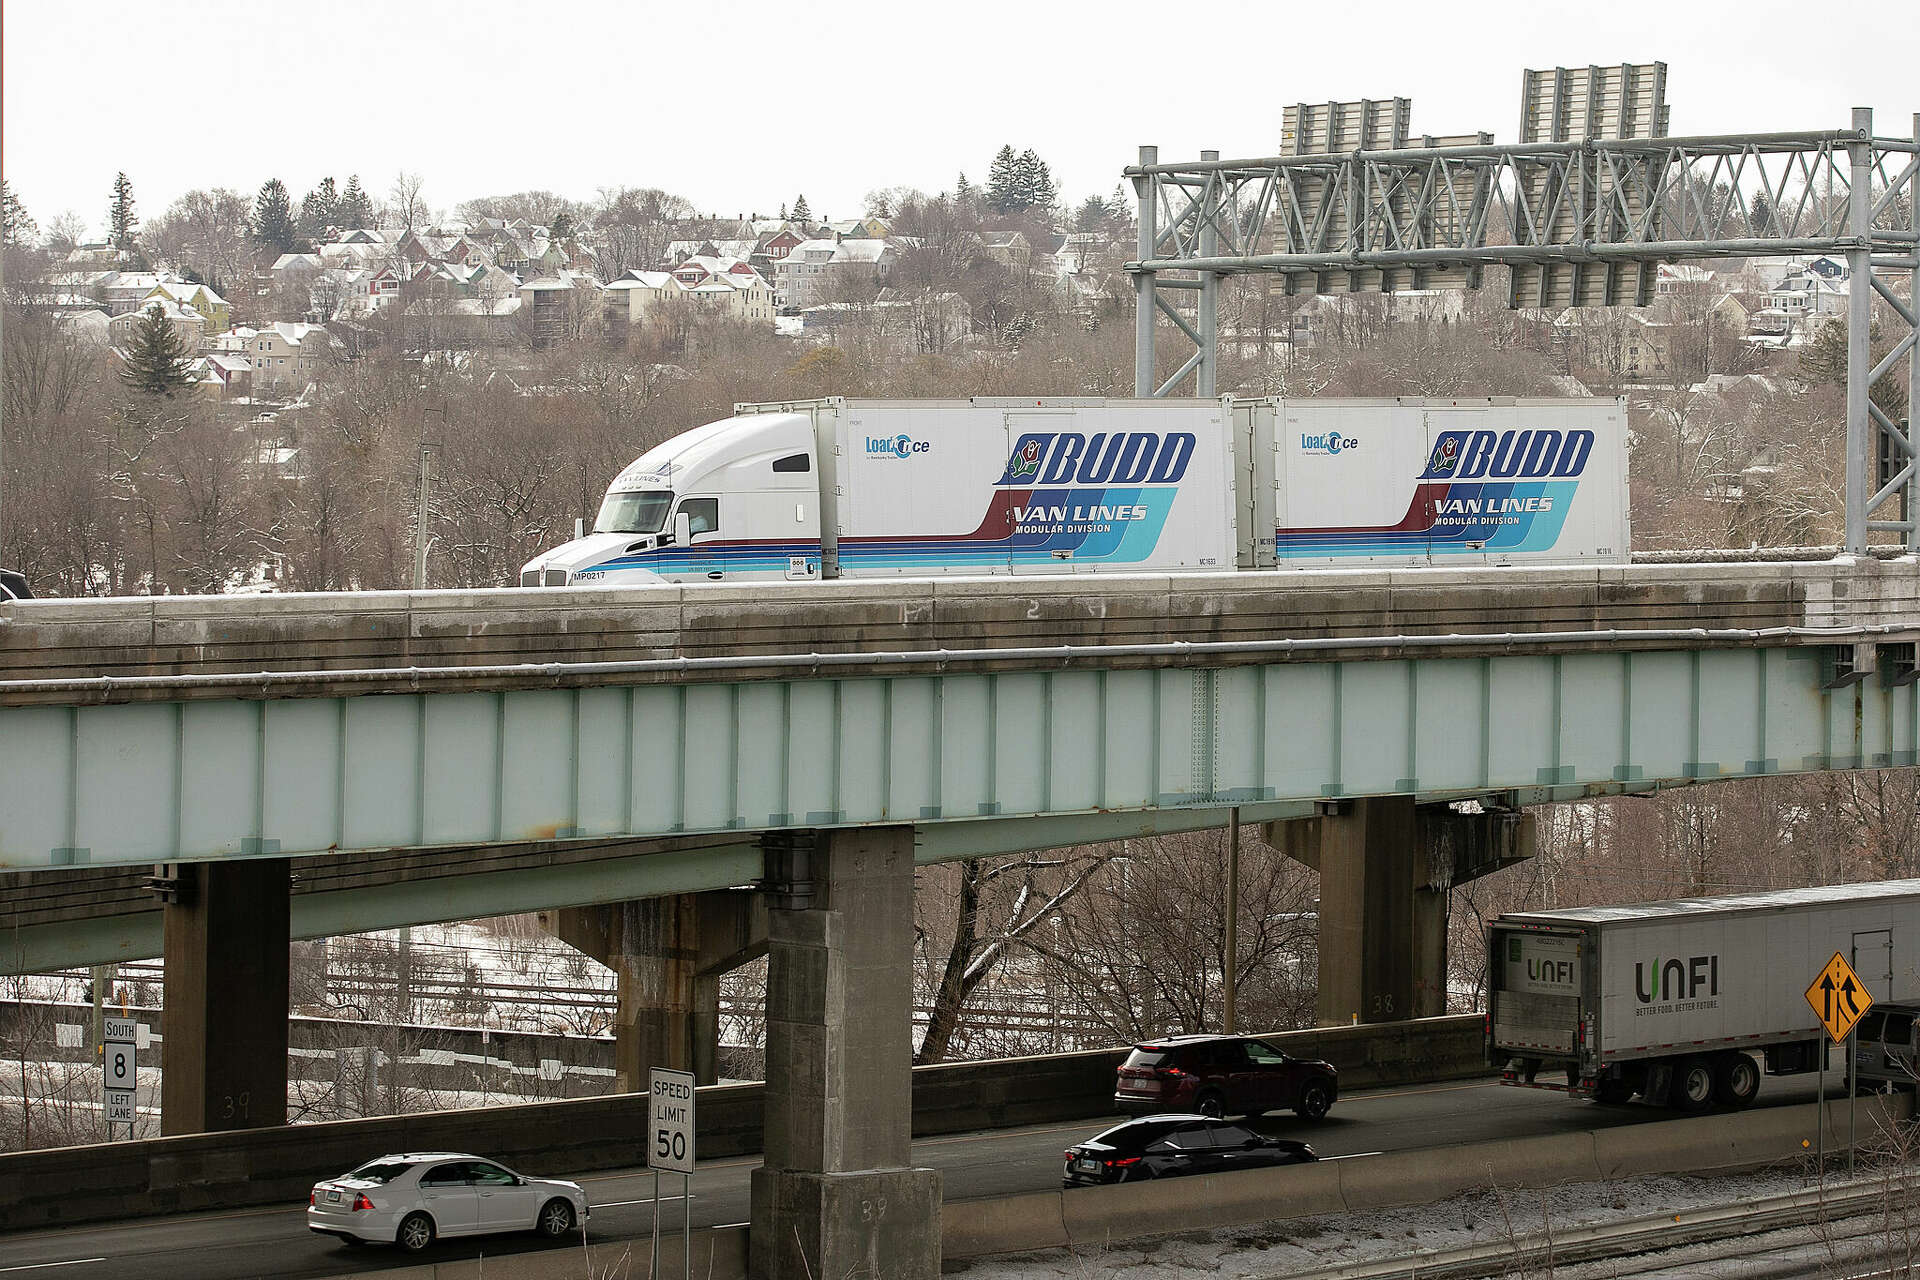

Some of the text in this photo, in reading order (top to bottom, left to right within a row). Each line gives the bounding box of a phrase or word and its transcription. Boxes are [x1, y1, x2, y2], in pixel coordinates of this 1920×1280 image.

[1038, 432, 1197, 484] BUDD
[1455, 429, 1595, 479] BUDD
[1013, 504, 1149, 523] VAN LINES
[1434, 497, 1554, 515] VAN LINES
[1015, 524, 1111, 535] MODULAR DIVISION
[1435, 516, 1520, 526] MODULAR DIVISION
[574, 571, 606, 581] MP0217
[1636, 1005, 1657, 1017] BETTER
[1675, 1001, 1695, 1012] BETTER
[106, 1021, 135, 1038] SOUTH
[114, 1053, 126, 1078] 8
[654, 1081, 690, 1099] SPEED
[110, 1094, 129, 1105] LEFT
[223, 1092, 249, 1120] 39
[109, 1108, 131, 1119] LANE
[657, 1105, 686, 1123] LIMIT
[657, 1129, 686, 1161] 50
